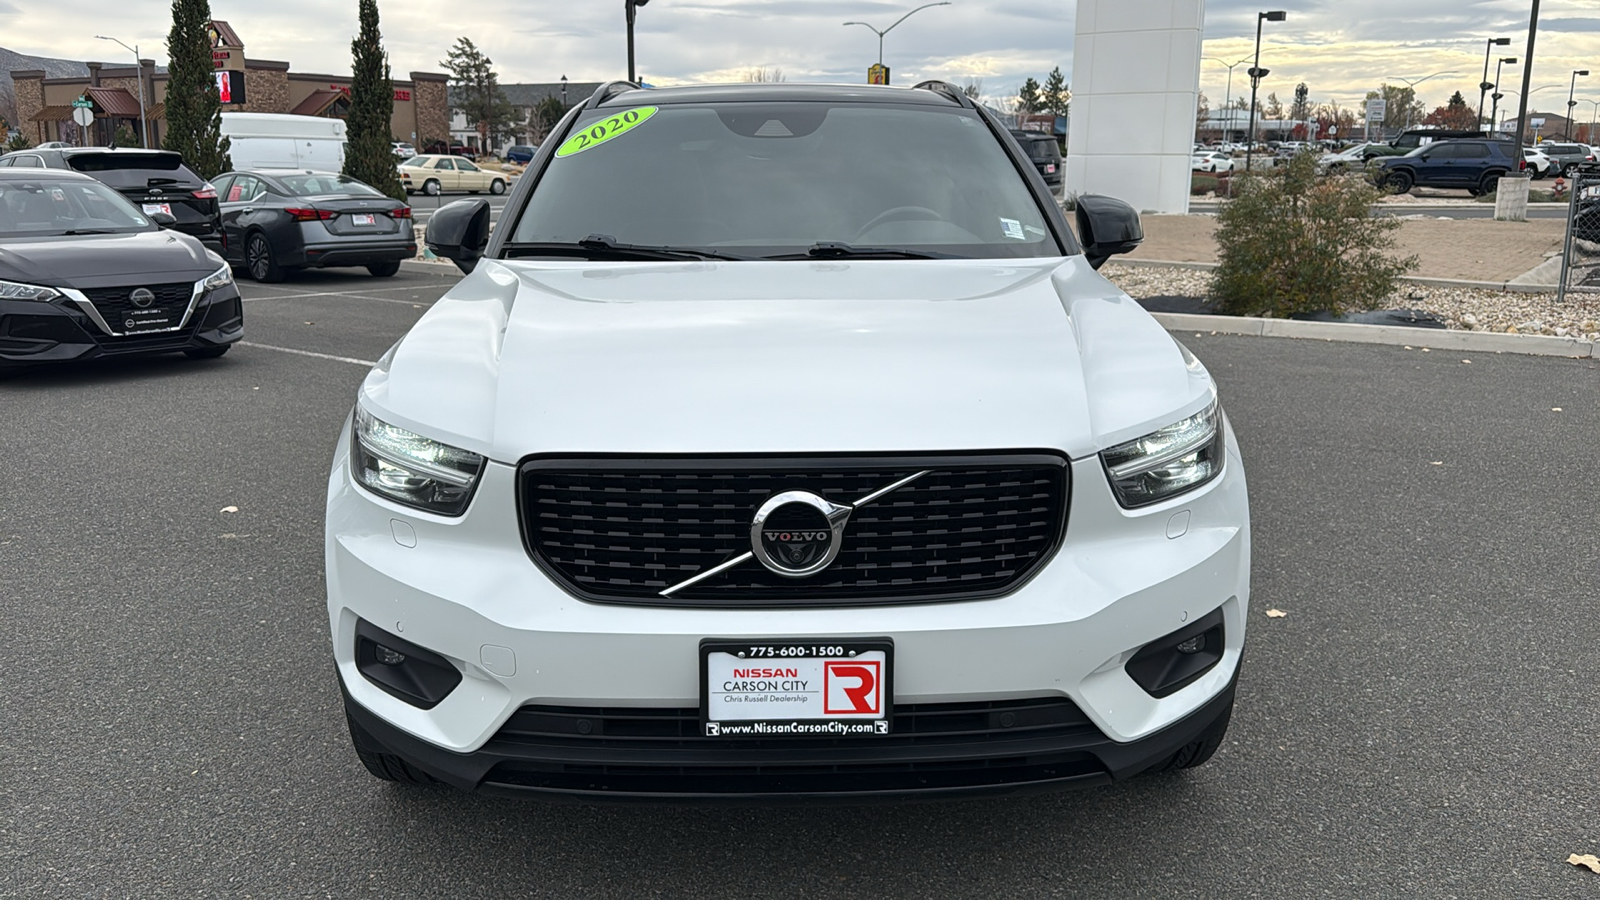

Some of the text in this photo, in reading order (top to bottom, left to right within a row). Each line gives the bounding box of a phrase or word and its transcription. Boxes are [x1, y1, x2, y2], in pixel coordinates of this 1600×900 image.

[574, 111, 639, 149] 2020
[765, 532, 828, 541] VOLVO
[750, 646, 844, 657] 775-600-1500
[733, 668, 798, 678] NISSAN
[723, 680, 809, 692] CARSON CITY
[829, 666, 875, 711] R
[724, 694, 808, 704] Chris Russell Dealership
[721, 721, 873, 735] www.NissanCarsonCity.com
